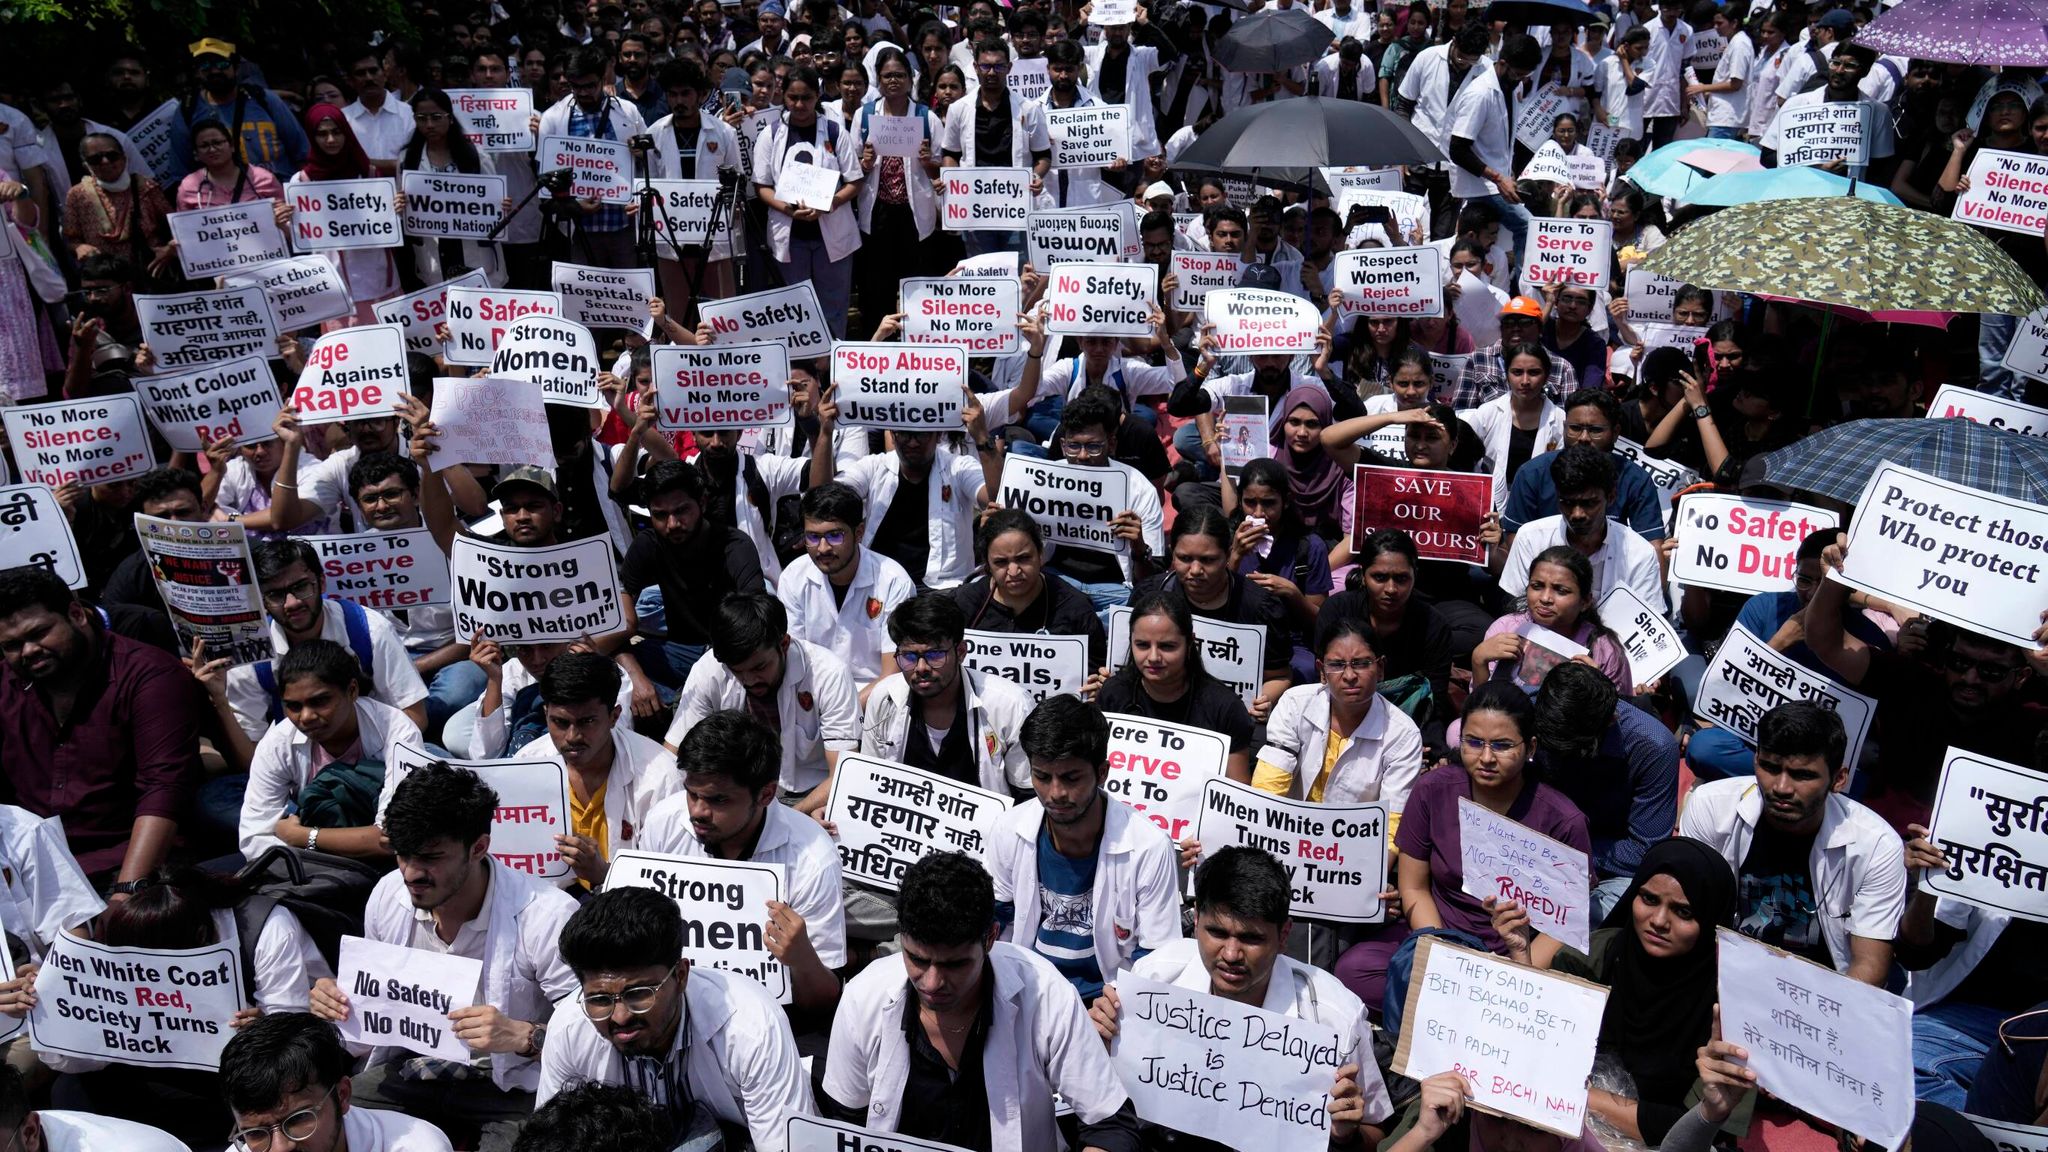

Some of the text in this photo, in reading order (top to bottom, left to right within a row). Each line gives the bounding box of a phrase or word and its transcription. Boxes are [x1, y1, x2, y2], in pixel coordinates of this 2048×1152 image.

[1023, 73, 1044, 84] PAIN
[1050, 112, 1120, 124] Reclaim the
[1067, 124, 1104, 138] Night
[561, 141, 615, 156] "No More
[1061, 139, 1112, 150] Save our
[556, 155, 619, 173] Silence,
[1059, 150, 1117, 164] Saviours
[1580, 162, 1595, 170] Pain
[1996, 157, 2019, 172] "No
[585, 171, 612, 183] More
[1340, 176, 1380, 187] She Saved
[425, 179, 486, 197] "Strong
[950, 179, 1023, 197] No Safety,
[297, 193, 387, 214] No Safety,
[409, 199, 503, 219] Women,
[1986, 190, 2047, 210] No More
[948, 203, 1025, 219] No Service
[197, 223, 259, 243] Delayed
[299, 221, 392, 240] No Service
[407, 217, 449, 232] Strong
[1539, 223, 1594, 236] Here To
[227, 241, 238, 252] is
[1536, 236, 1594, 252] Serve
[189, 248, 283, 273] Justice Denied
[1175, 257, 1211, 271] "Stop
[1352, 253, 1418, 269] "Respect
[1541, 252, 1587, 265] Not To
[287, 263, 326, 283] those
[578, 270, 625, 285] Secure
[1190, 274, 1222, 288] Stand
[1350, 269, 1420, 285] Women,
[1529, 264, 1600, 286] Suffer
[561, 283, 649, 305] Hospitals,
[926, 284, 995, 296] "No More
[1058, 277, 1145, 300] No Safety,
[1230, 291, 1297, 303] "Respect
[1362, 286, 1410, 299] Reject
[279, 302, 305, 320] you
[450, 301, 473, 319] No
[585, 299, 633, 312] Secure
[921, 299, 1001, 319] Silence,
[1053, 304, 1147, 324] No Service
[1228, 302, 1299, 317] Women,
[1341, 298, 1433, 314] Violence!"
[1627, 309, 1672, 321] Justice
[151, 316, 222, 335] राहणार
[580, 311, 644, 328] Futures
[711, 317, 739, 335] No
[930, 320, 993, 331] No More
[1239, 318, 1287, 331] Reject
[461, 333, 485, 350] No
[510, 326, 576, 347] "Strong
[1216, 332, 1312, 349] Violence!"
[680, 351, 761, 367] "No More
[896, 351, 961, 376] Abuse,
[321, 362, 403, 387] Against
[676, 370, 768, 388] Silence,
[147, 385, 193, 402] Dont
[860, 378, 939, 395] Stand for
[295, 385, 383, 415] Rape
[688, 390, 760, 404] No More
[22, 406, 108, 427] "No More
[152, 404, 211, 424] White
[664, 403, 785, 424] Violence!"
[845, 402, 956, 423] Justice!"
[24, 424, 120, 449] Silence,
[37, 444, 114, 466] No More
[1394, 477, 1452, 497] SAVE
[1394, 503, 1443, 521] OUR
[1882, 485, 1982, 534] Protect
[322, 536, 409, 556] Here To
[1879, 515, 2040, 584] Who protect
[324, 552, 415, 577] Serve
[477, 553, 579, 578] "Strong
[1696, 545, 1728, 569] No
[336, 573, 409, 590] Not To
[1919, 567, 1969, 597] you
[458, 577, 612, 612] Women,
[1020, 644, 1057, 660] Who
[1158, 729, 1185, 750] To
[1141, 780, 1168, 802] To
[847, 795, 941, 839] राहणार
[937, 793, 979, 821] शांत
[1209, 789, 1259, 823] When
[1266, 808, 1325, 837] White
[1331, 818, 1379, 838] Coat
[1488, 822, 1558, 862] Want to Be
[1298, 840, 1344, 865] Red,
[1501, 844, 1535, 868] SAFE
[1303, 863, 1362, 886] Turns
[1465, 845, 1550, 895] NOT TO Be
[91, 954, 230, 988] White Coat
[1456, 956, 1543, 1001] THEY SAID:
[353, 970, 380, 998] No
[63, 975, 193, 1014] Turns Red,
[1429, 972, 1576, 1033] BETI BETI
[1816, 993, 1842, 1018] हम
[56, 997, 219, 1035] Society Turns
[364, 1010, 442, 1049] No duty
[1136, 991, 1339, 1074] Justice Delayed
[1426, 1019, 1457, 1046] BETI
[104, 1028, 172, 1054] Black
[1205, 1048, 1225, 1070] is
[1139, 1056, 1327, 1130] Justice Denied
[1492, 1076, 1538, 1105] BACHI
